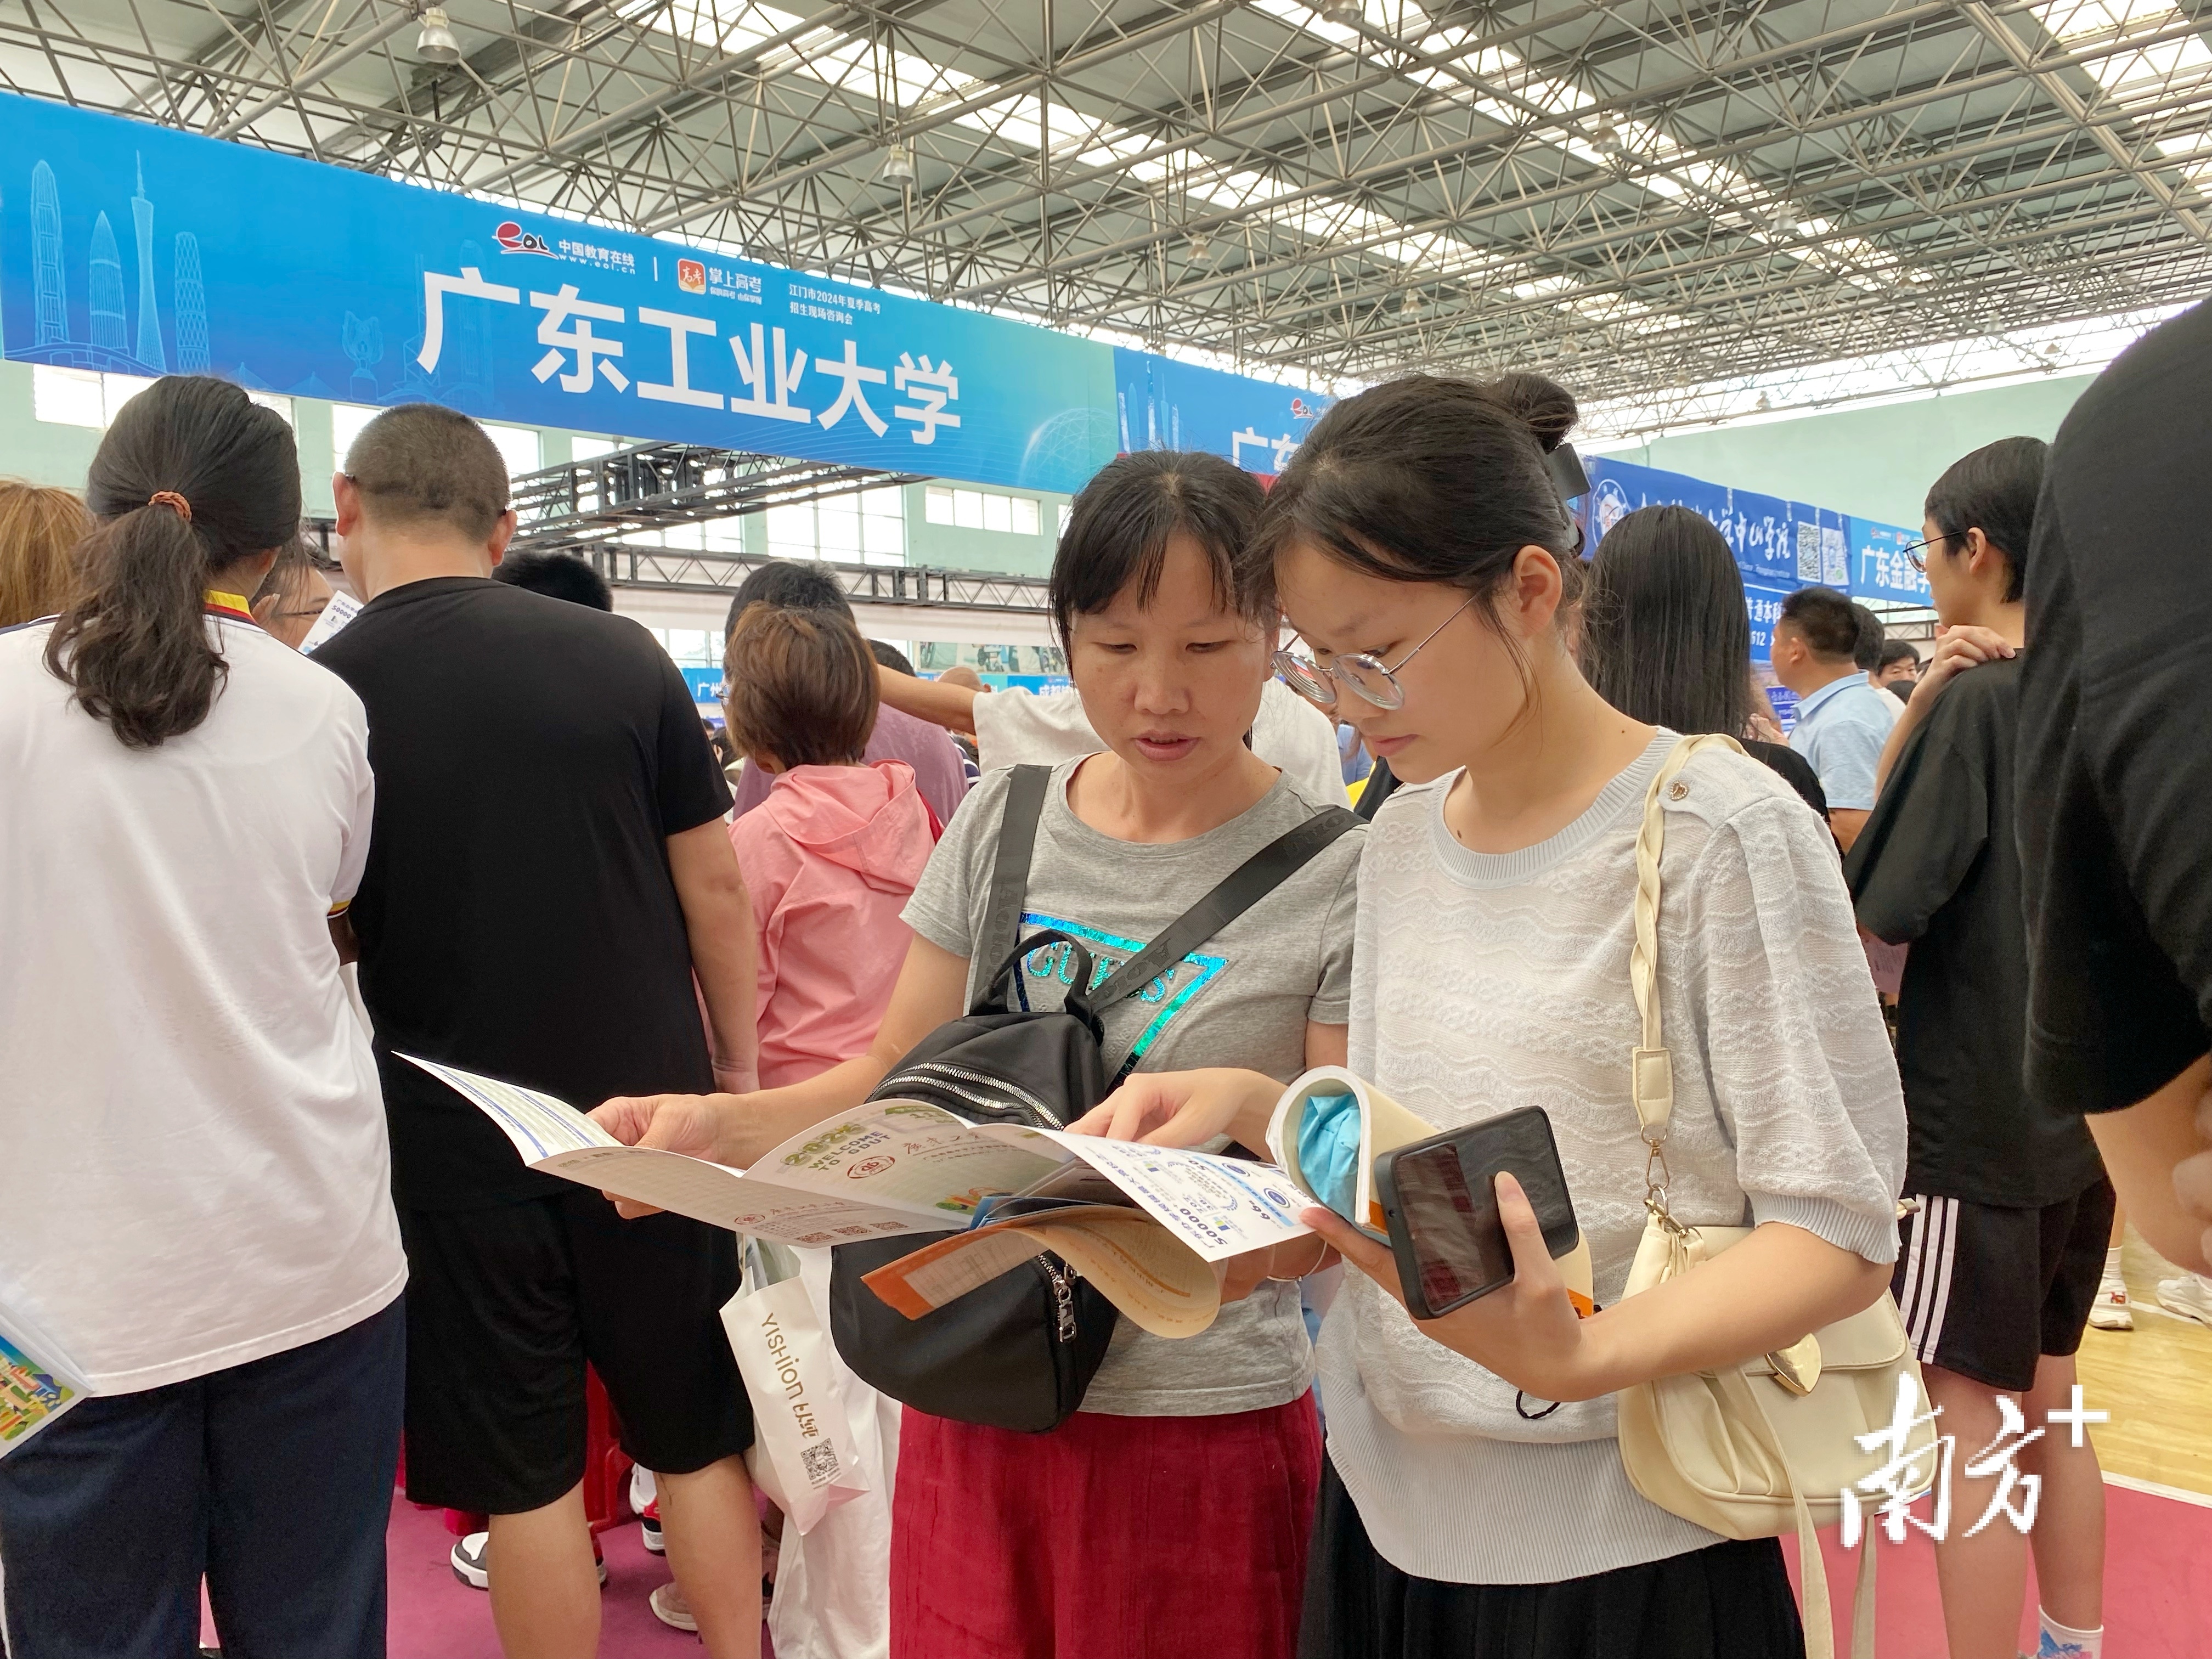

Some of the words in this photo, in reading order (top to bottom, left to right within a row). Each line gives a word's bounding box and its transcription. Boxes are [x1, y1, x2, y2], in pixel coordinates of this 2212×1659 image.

[558, 239, 635, 267] 中国教育在线
[558, 253, 636, 274] www.eol.cn
[709, 267, 761, 294] 掌上高考
[789, 284, 881, 314] 江门市2024年夏季高考
[789, 301, 853, 325] 招生现场咨询会
[416, 267, 961, 446] 广东工业大学
[808, 1131, 883, 1170] WELCOME
[817, 1159, 841, 1171] TO
[848, 1134, 891, 1155] GDUT
